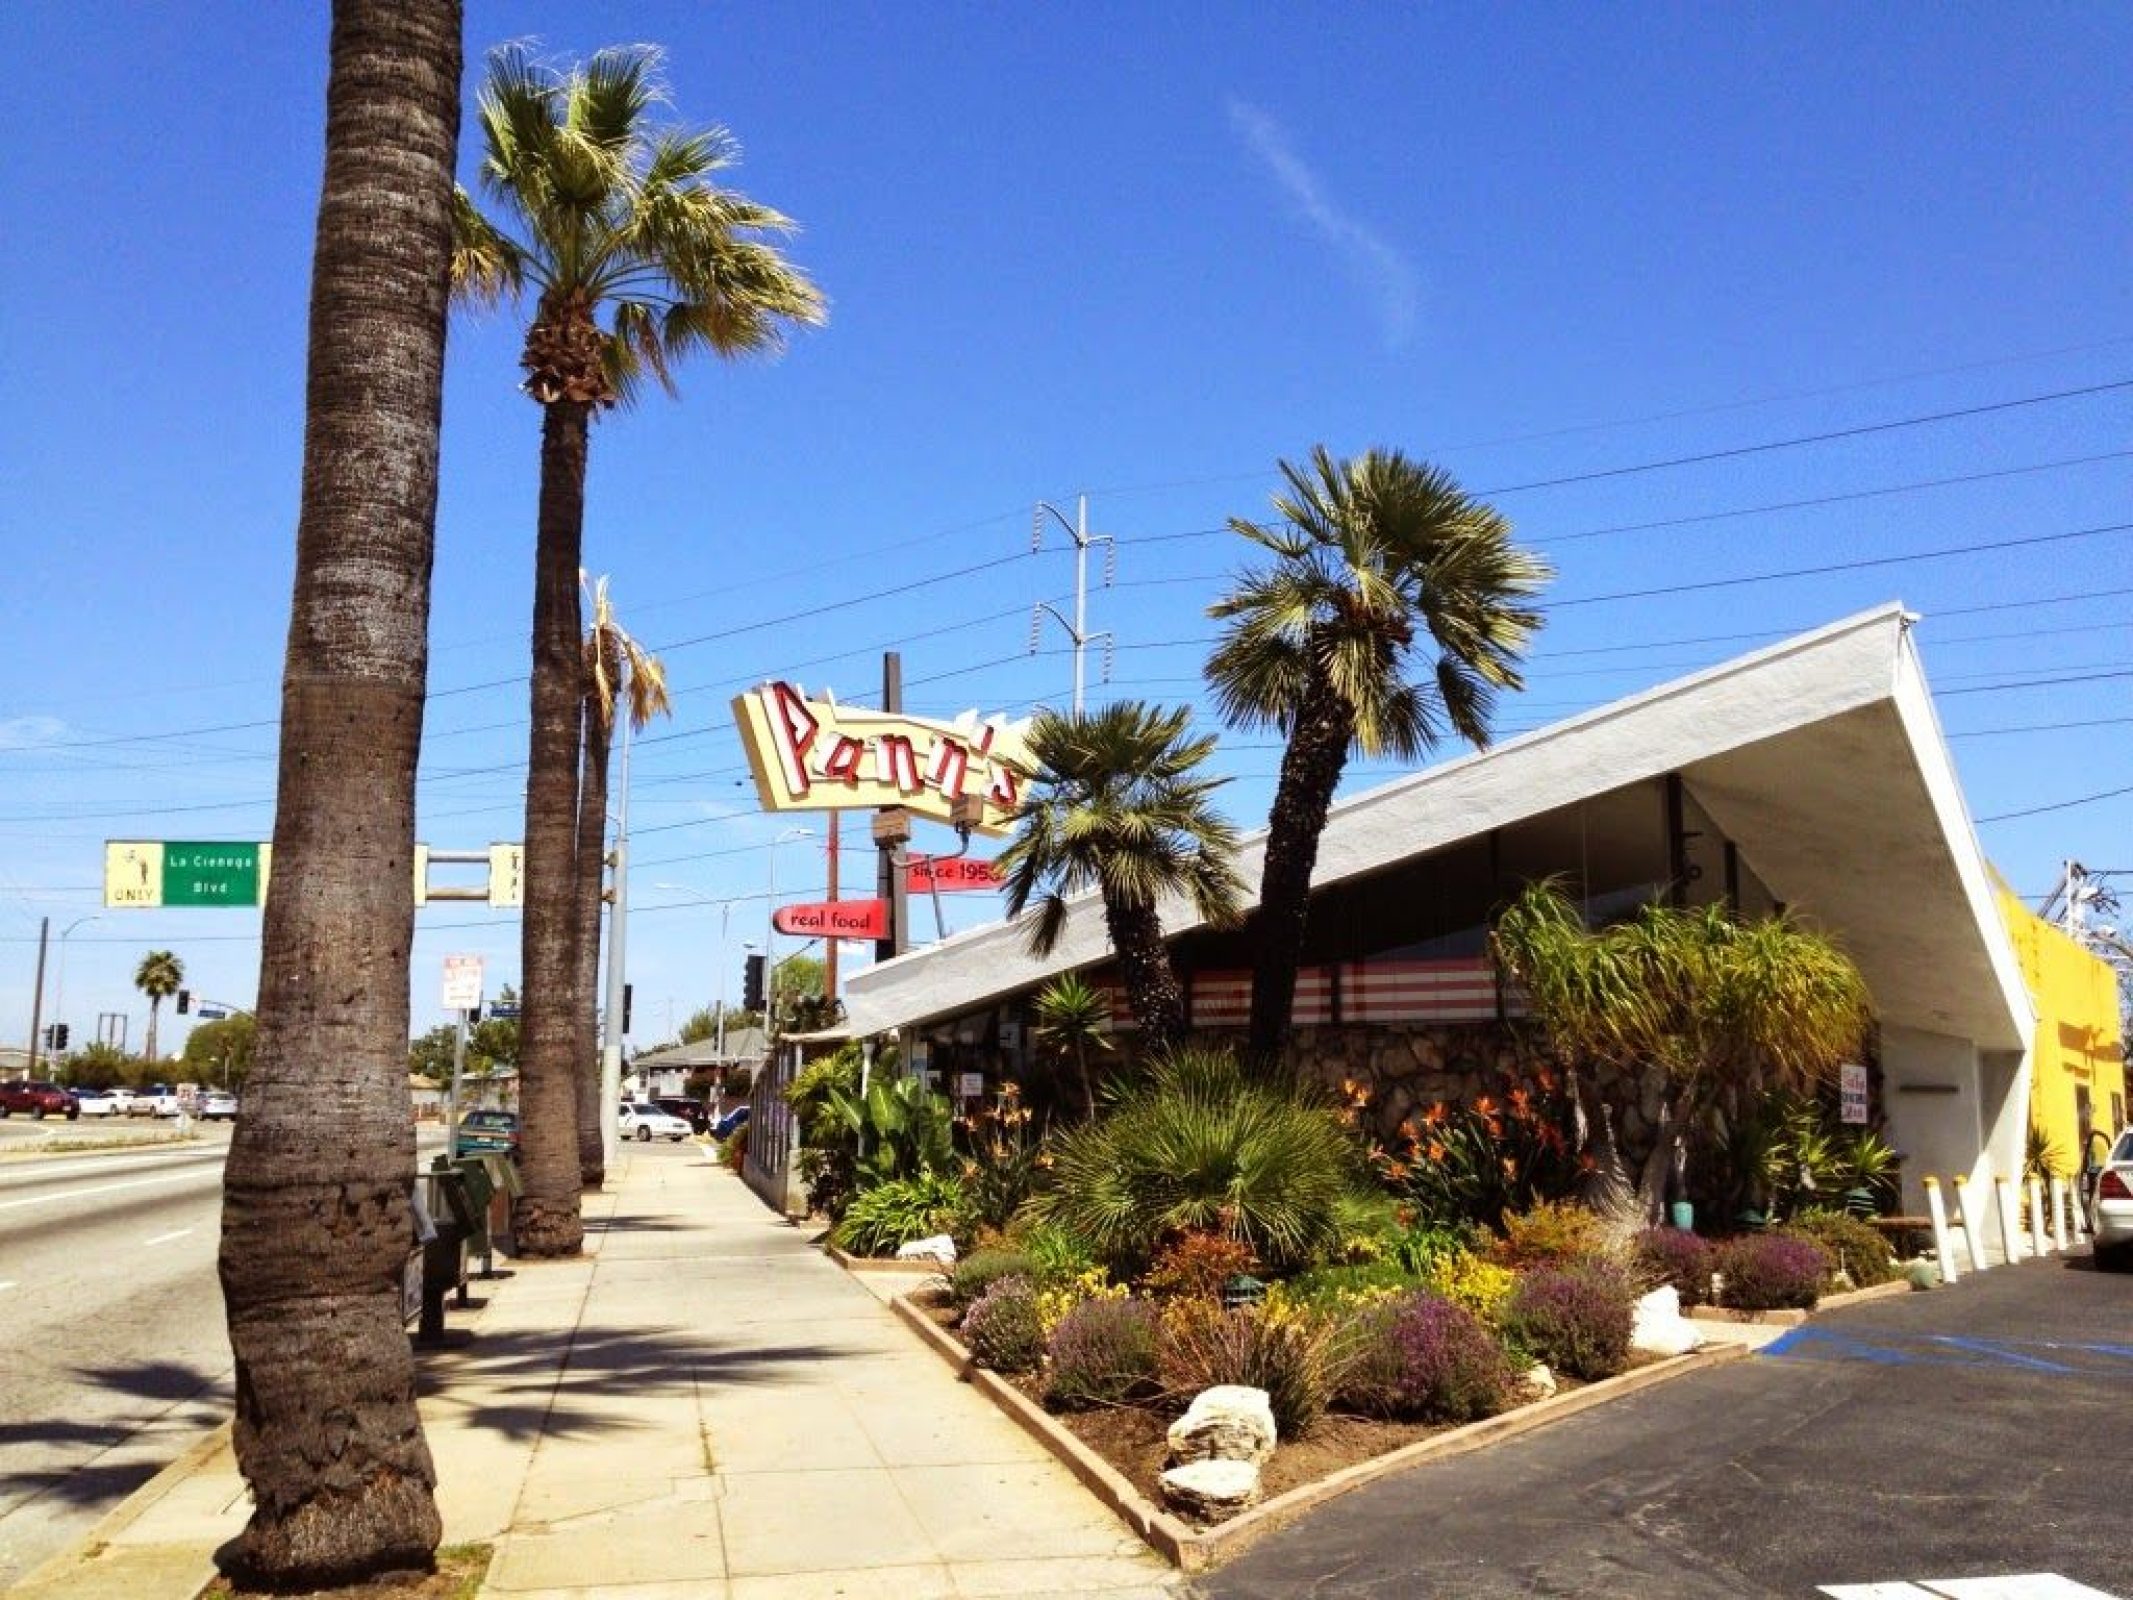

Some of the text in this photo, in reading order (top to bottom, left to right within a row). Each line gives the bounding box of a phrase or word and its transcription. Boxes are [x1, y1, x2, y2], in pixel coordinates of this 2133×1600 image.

[760, 681, 1018, 809] Pann's
[170, 856, 252, 870] La Cienega
[913, 867, 954, 878] since
[193, 881, 228, 893] Blvd
[115, 889, 153, 901] ONLY
[791, 911, 870, 930] real food
